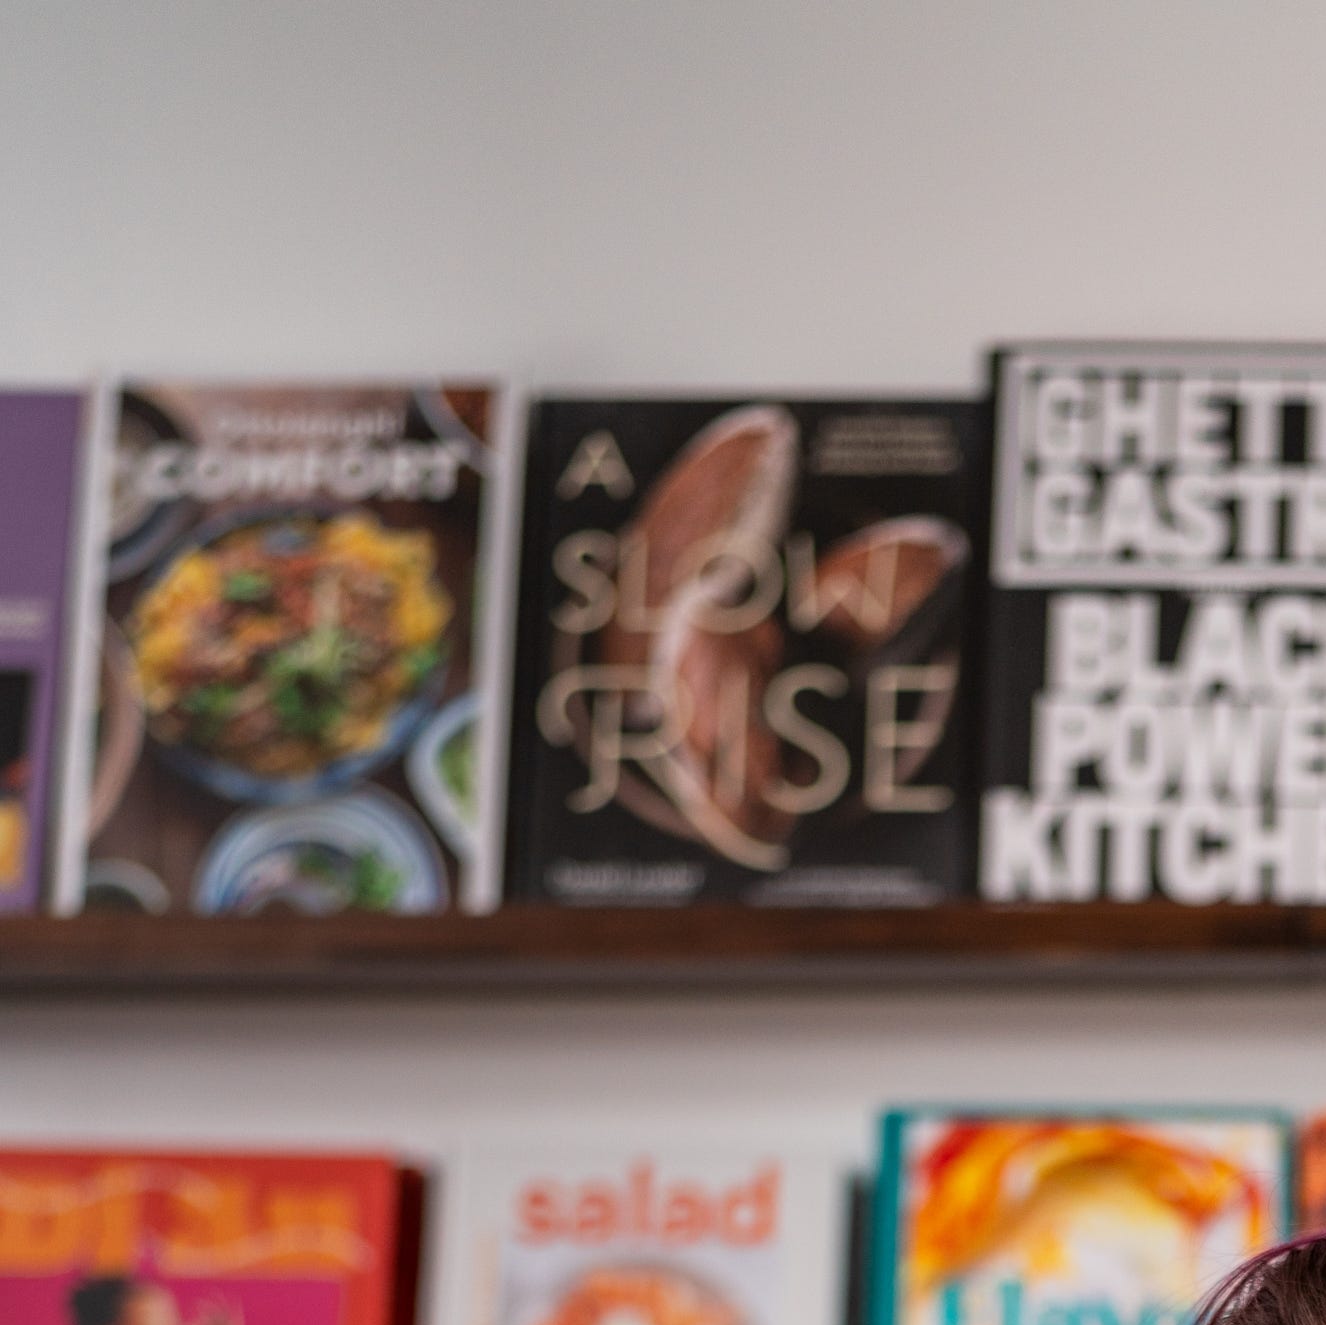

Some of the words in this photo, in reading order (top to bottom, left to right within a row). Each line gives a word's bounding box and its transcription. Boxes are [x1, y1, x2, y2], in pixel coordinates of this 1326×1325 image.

[138, 440, 464, 498] COMFORT
[560, 431, 632, 498] A
[552, 530, 900, 632] SLOW
[538, 664, 957, 870] RISE
[519, 1158, 782, 1245] salad
